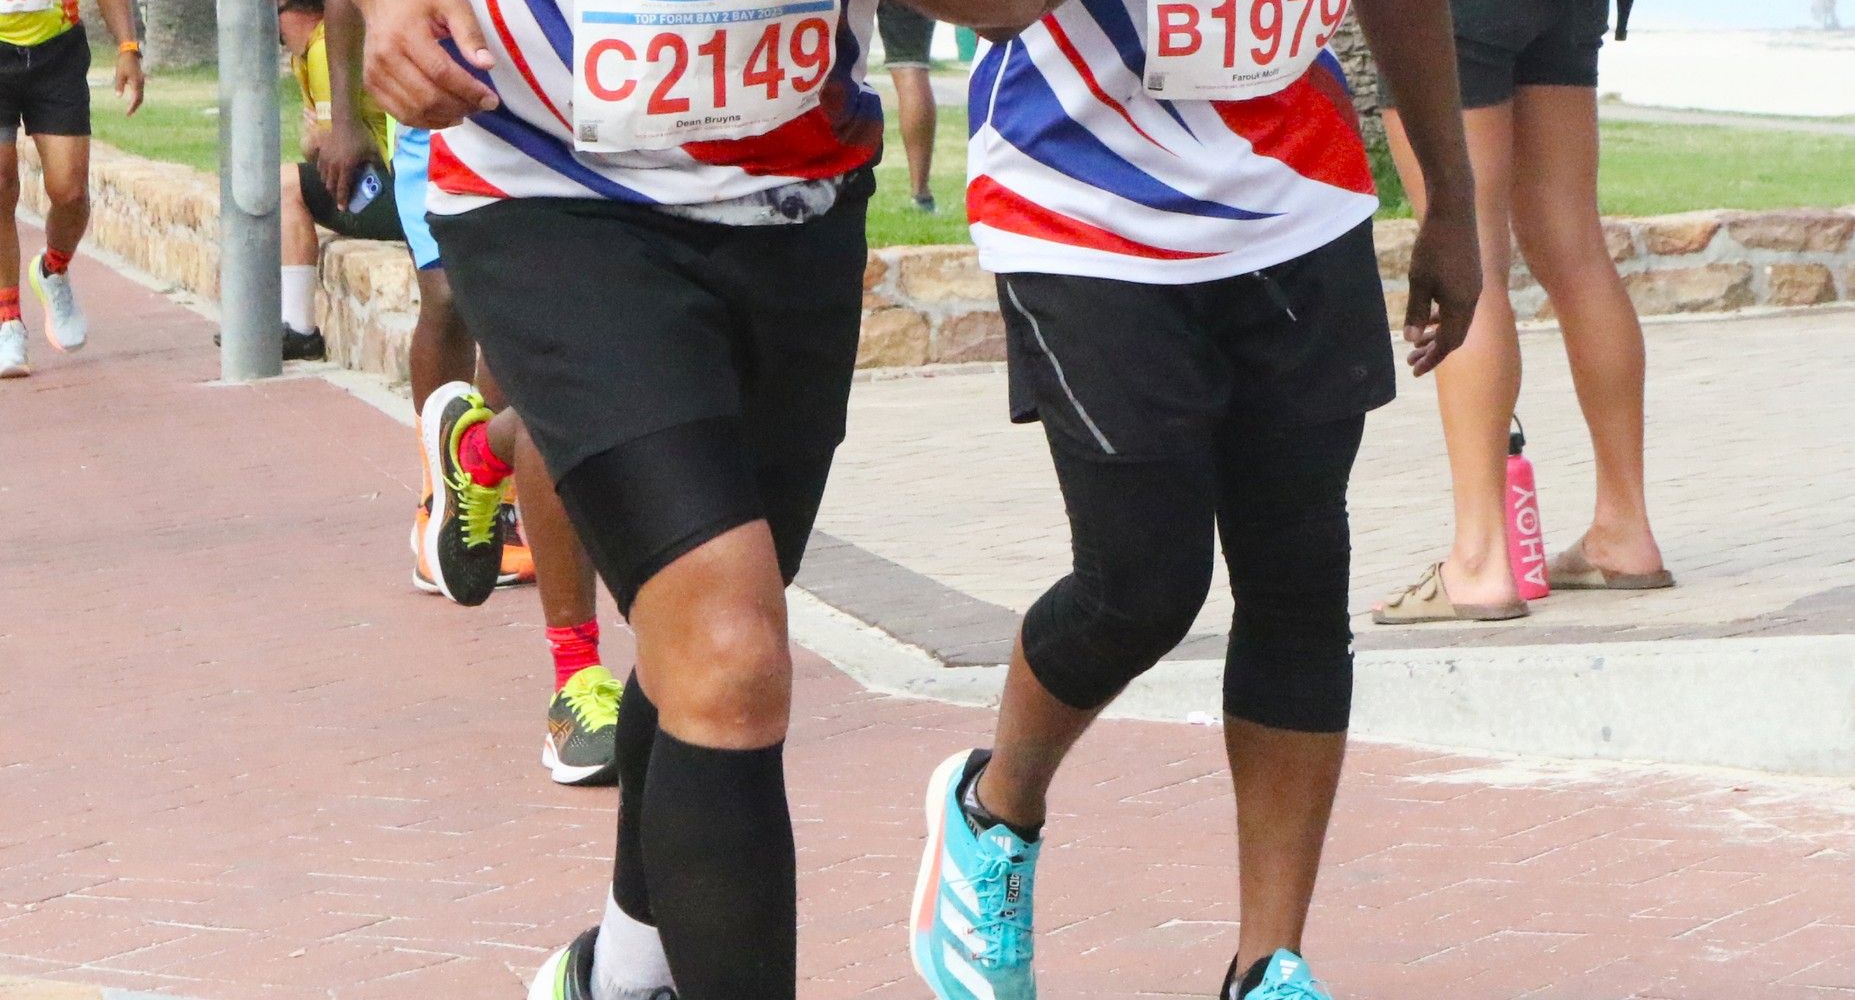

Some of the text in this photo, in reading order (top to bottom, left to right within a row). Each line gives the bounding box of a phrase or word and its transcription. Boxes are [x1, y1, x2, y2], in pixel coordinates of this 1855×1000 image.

[635, 13, 657, 25] TOP
[660, 13, 693, 24] FORM
[696, 11, 720, 23] BAY
[722, 11, 729, 22] 2
[732, 10, 755, 21] BAY
[584, 17, 830, 115] C2149
[676, 114, 741, 128] Dean Bruyns
[1512, 485, 1547, 586] AHOY
